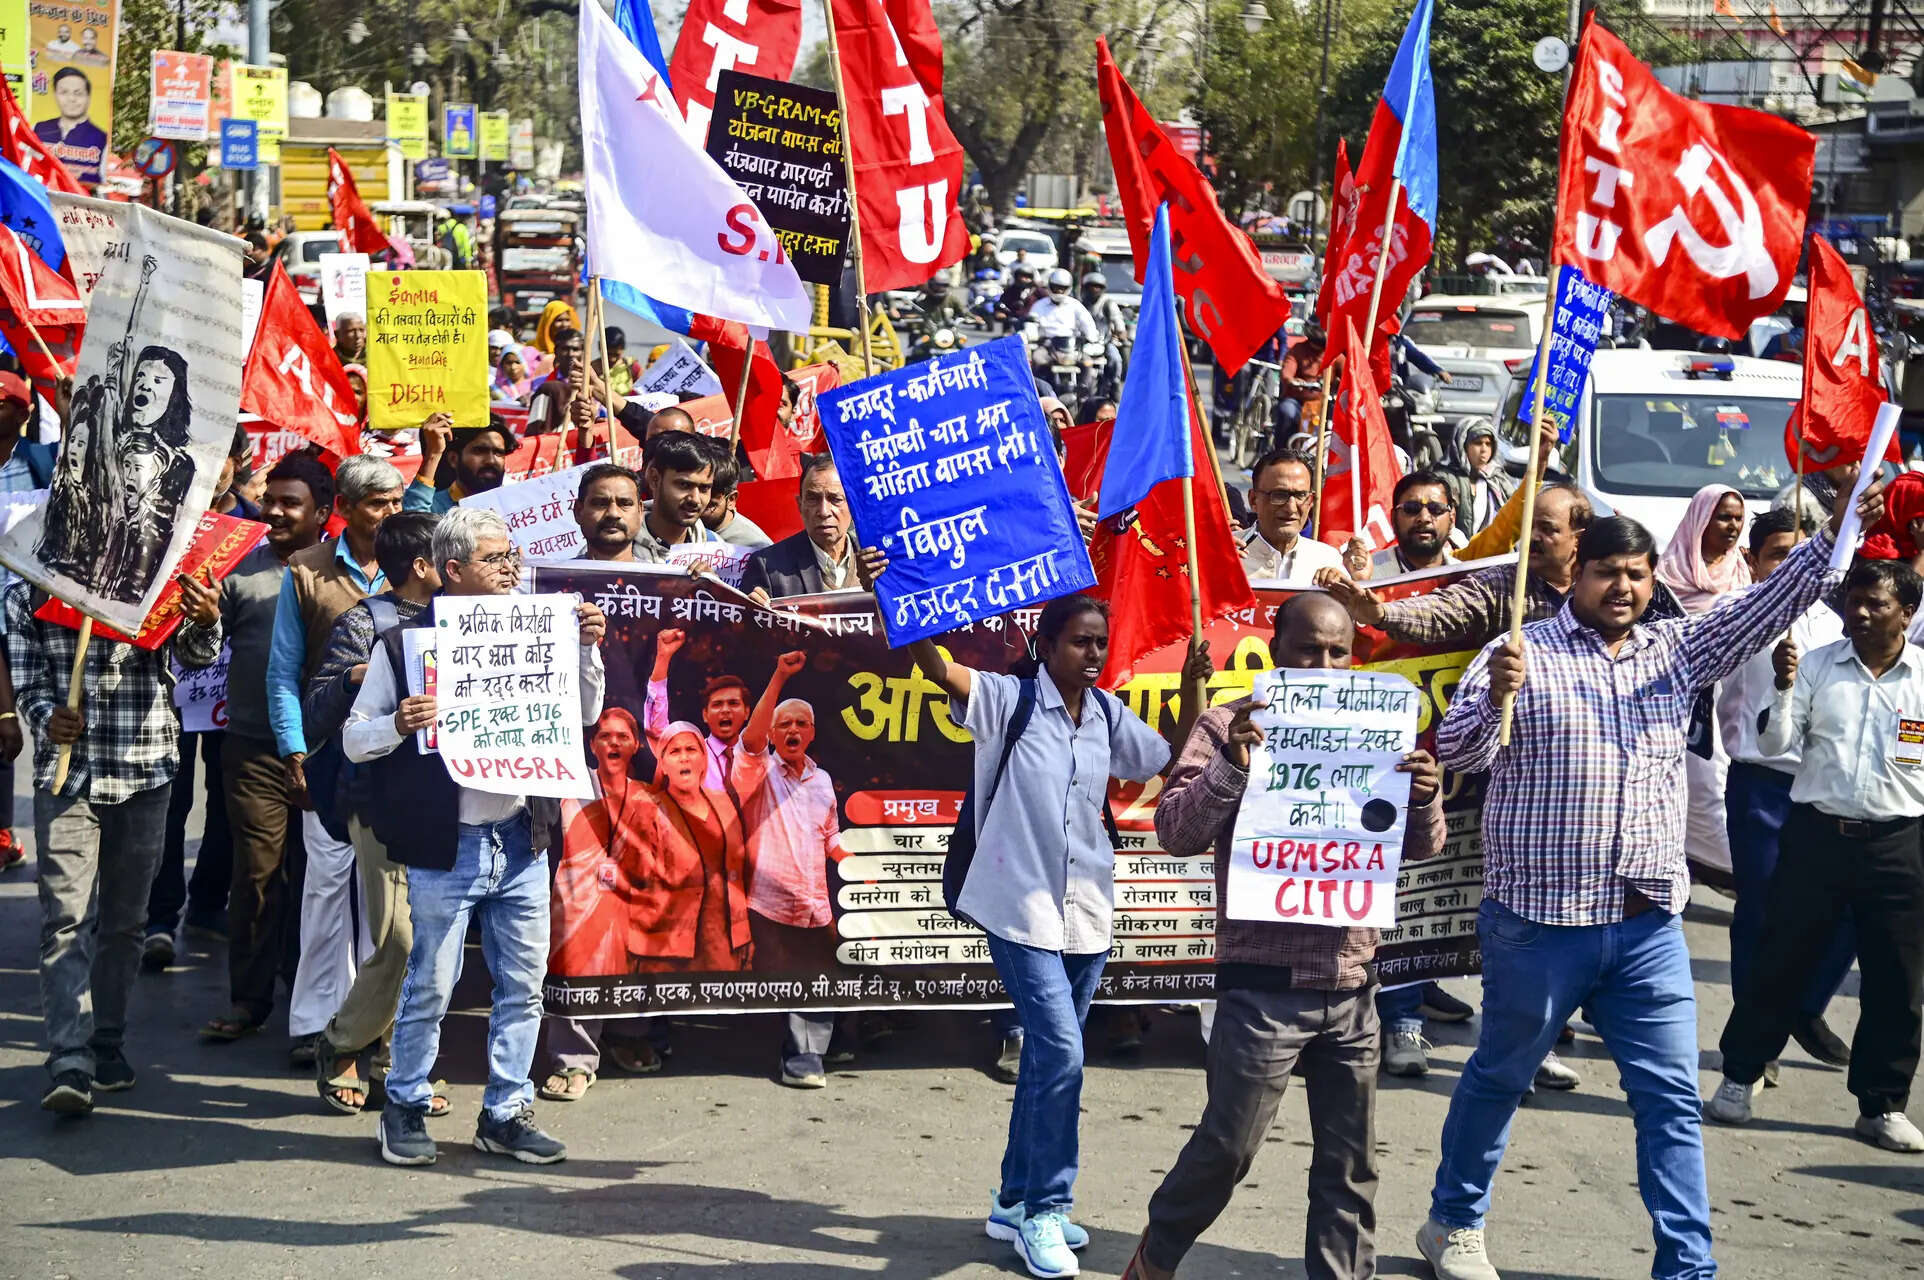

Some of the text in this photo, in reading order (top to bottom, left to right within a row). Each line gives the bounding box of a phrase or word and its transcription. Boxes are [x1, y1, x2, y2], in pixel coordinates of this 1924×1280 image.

[781, 129, 823, 152] वापस
[1576, 59, 1634, 262] CITU
[804, 231, 840, 257] दस्ता
[1265, 255, 1300, 265] GROUP
[376, 308, 390, 326] की
[461, 307, 477, 326] की
[387, 383, 447, 407] DISHA
[929, 416, 969, 446] चार
[935, 446, 994, 483] वापस
[528, 530, 579, 557] व्यवस्था
[506, 604, 556, 635] विरोधी
[595, 584, 663, 620] केंद्रीय
[670, 589, 746, 625] श्रमिक
[818, 611, 875, 638] राज्य
[452, 645, 485, 669] चार
[525, 636, 556, 666] कोड
[455, 673, 478, 698] को
[1266, 669, 1330, 714] सेल्स
[1334, 676, 1414, 716] प्रोमोशन
[445, 708, 481, 734] SPE
[525, 702, 563, 723] 1976
[473, 726, 495, 749] को
[494, 727, 526, 749] लागू
[450, 756, 577, 781] UPMSRA
[1265, 762, 1375, 798] 1976 लागू
[884, 798, 941, 824] प्रमुख
[1446, 815, 1465, 831] पस
[893, 834, 926, 850] चार
[1119, 835, 1148, 850] पस
[881, 862, 944, 880] न्यूनतम
[1128, 856, 1190, 877] प्रतिमाह
[1251, 839, 1386, 875] UPMSRA
[1416, 867, 1454, 886] तत्काल
[849, 885, 1213, 906] मनरेगा को रोजगार एवं
[1274, 877, 1375, 922] CITU
[1399, 898, 1426, 914] चालू
[1112, 912, 1180, 933] जीकरण
[1190, 914, 1216, 932] बंद
[1379, 923, 1404, 943] चारी
[1409, 924, 1424, 939] का
[849, 942, 880, 962] बीज
[890, 940, 951, 961] संशोधन
[1135, 943, 1178, 960] वापस
[1121, 970, 1152, 991] केन्द्र
[1153, 973, 1182, 990] तथा
[1183, 972, 1217, 990] राज्य
